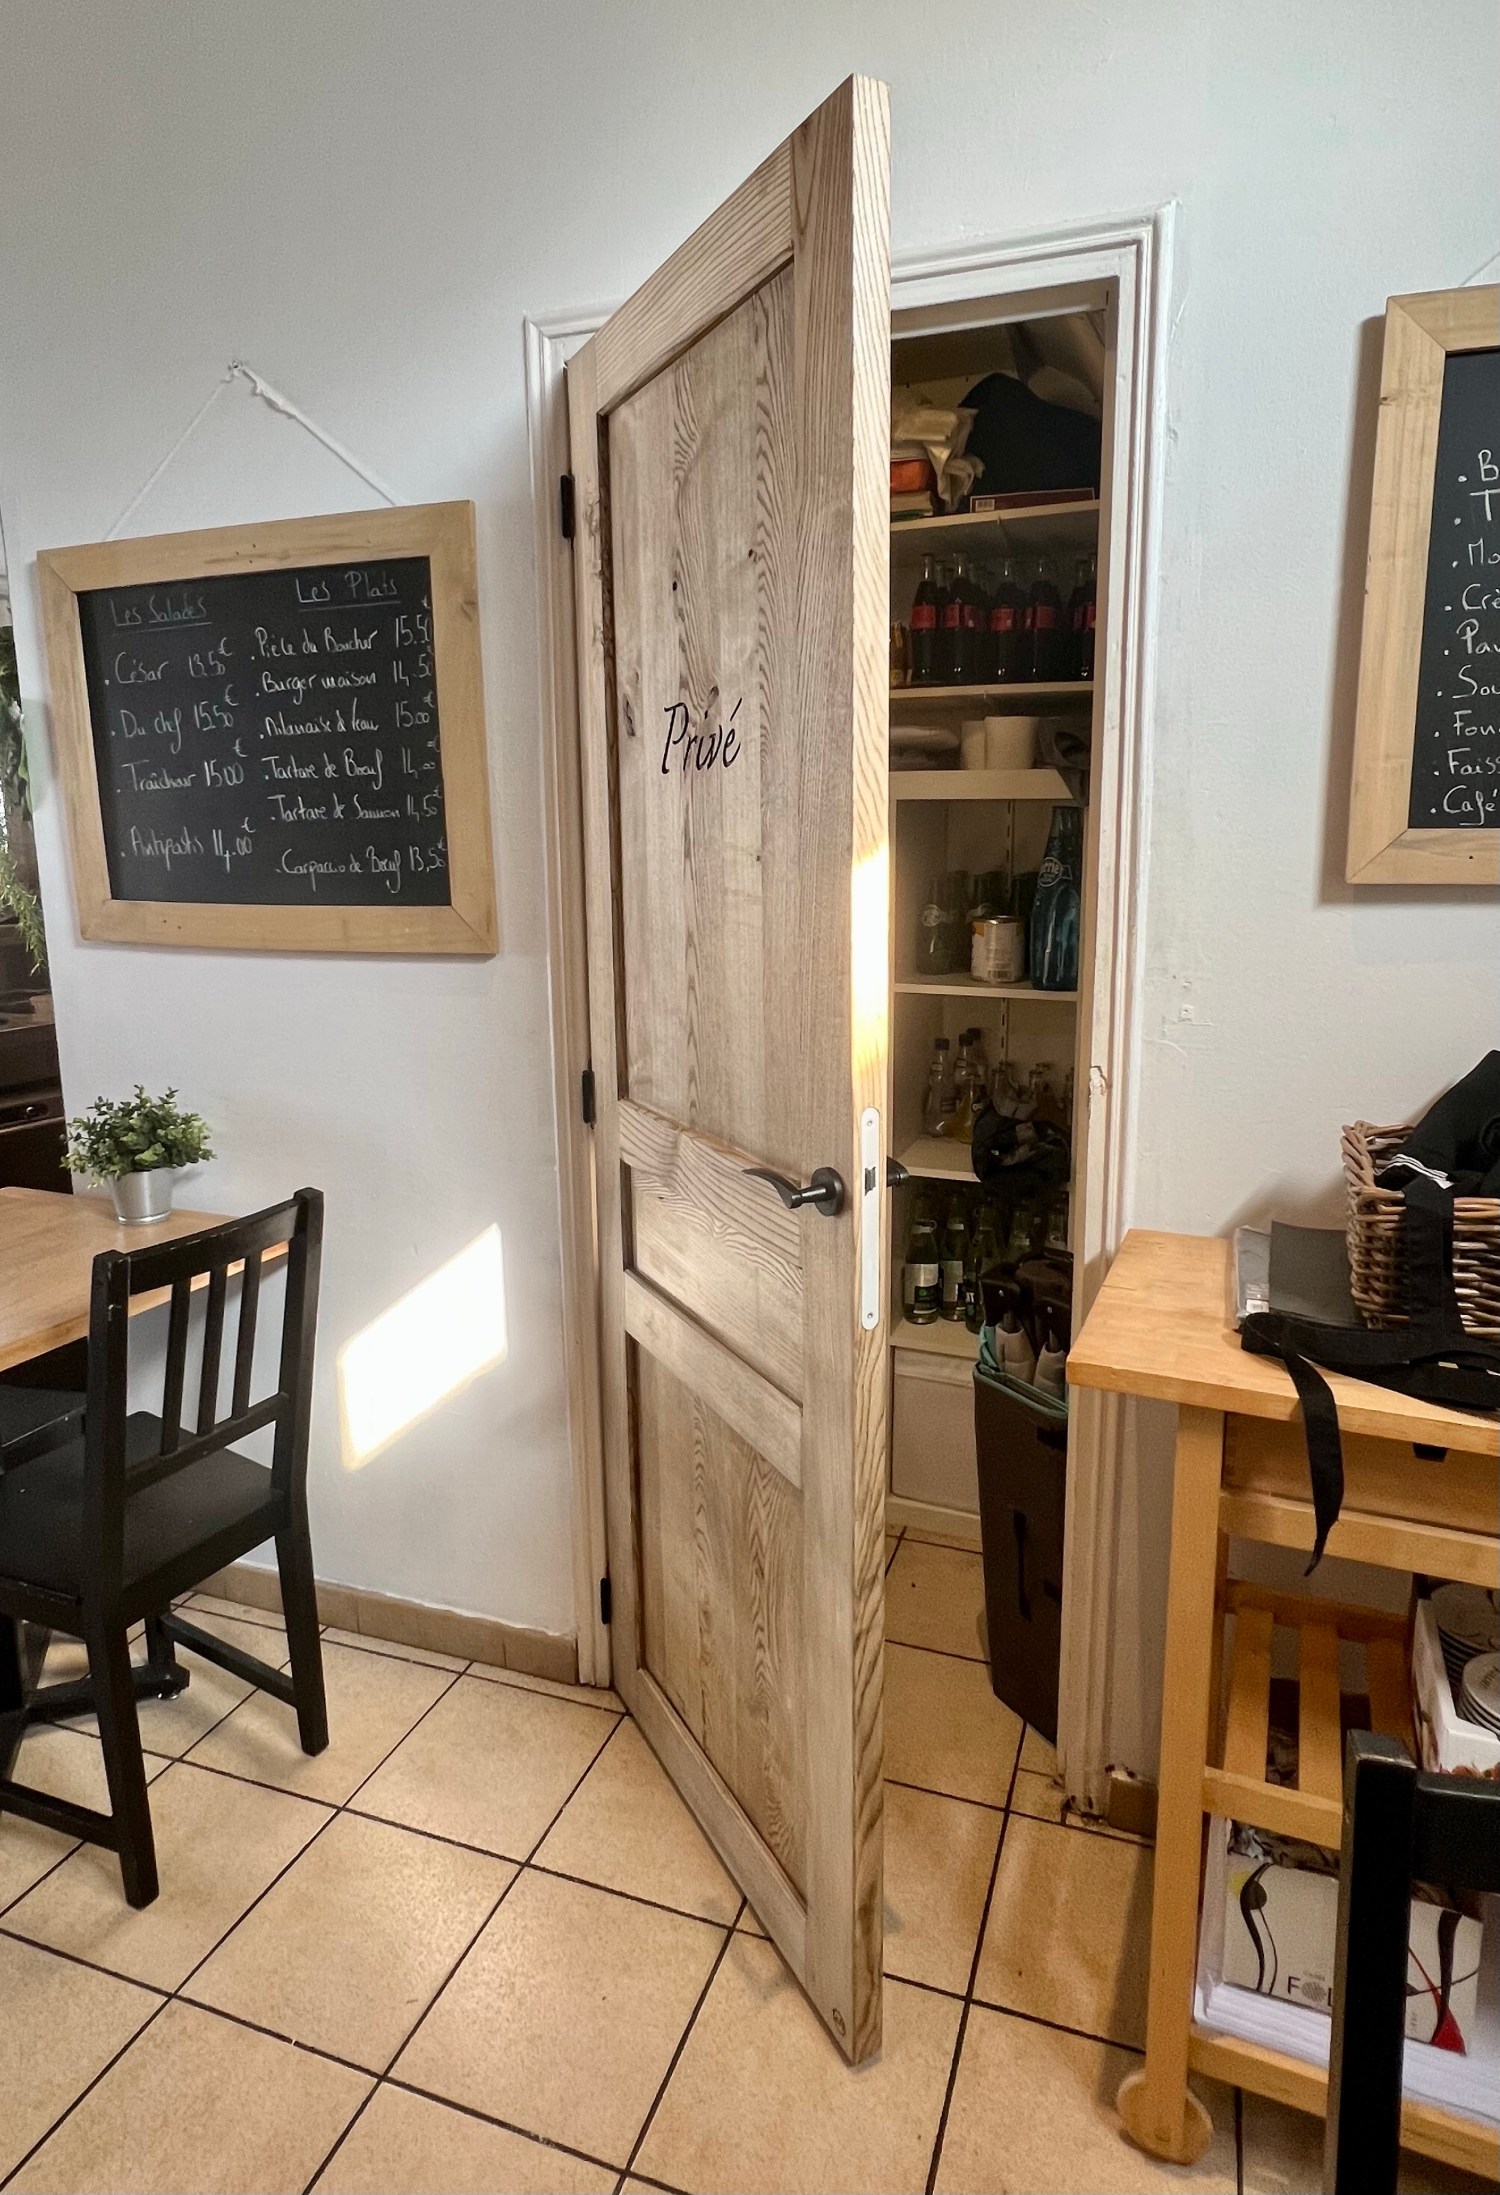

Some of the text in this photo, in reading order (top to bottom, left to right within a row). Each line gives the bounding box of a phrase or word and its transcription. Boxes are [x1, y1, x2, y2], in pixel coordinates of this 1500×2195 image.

[295, 570, 398, 603] Les Plats
[110, 592, 207, 626] Les Salades
[302, 628, 319, 655] du
[262, 671, 318, 706] Burger
[321, 671, 377, 690] maison
[120, 709, 147, 738] Du
[154, 707, 182, 755] chef
[661, 697, 743, 775] Privé
[261, 755, 320, 779] Tartare
[323, 752, 340, 778] de
[267, 794, 328, 821] Tartare
[1442, 784, 1499, 826] Café
